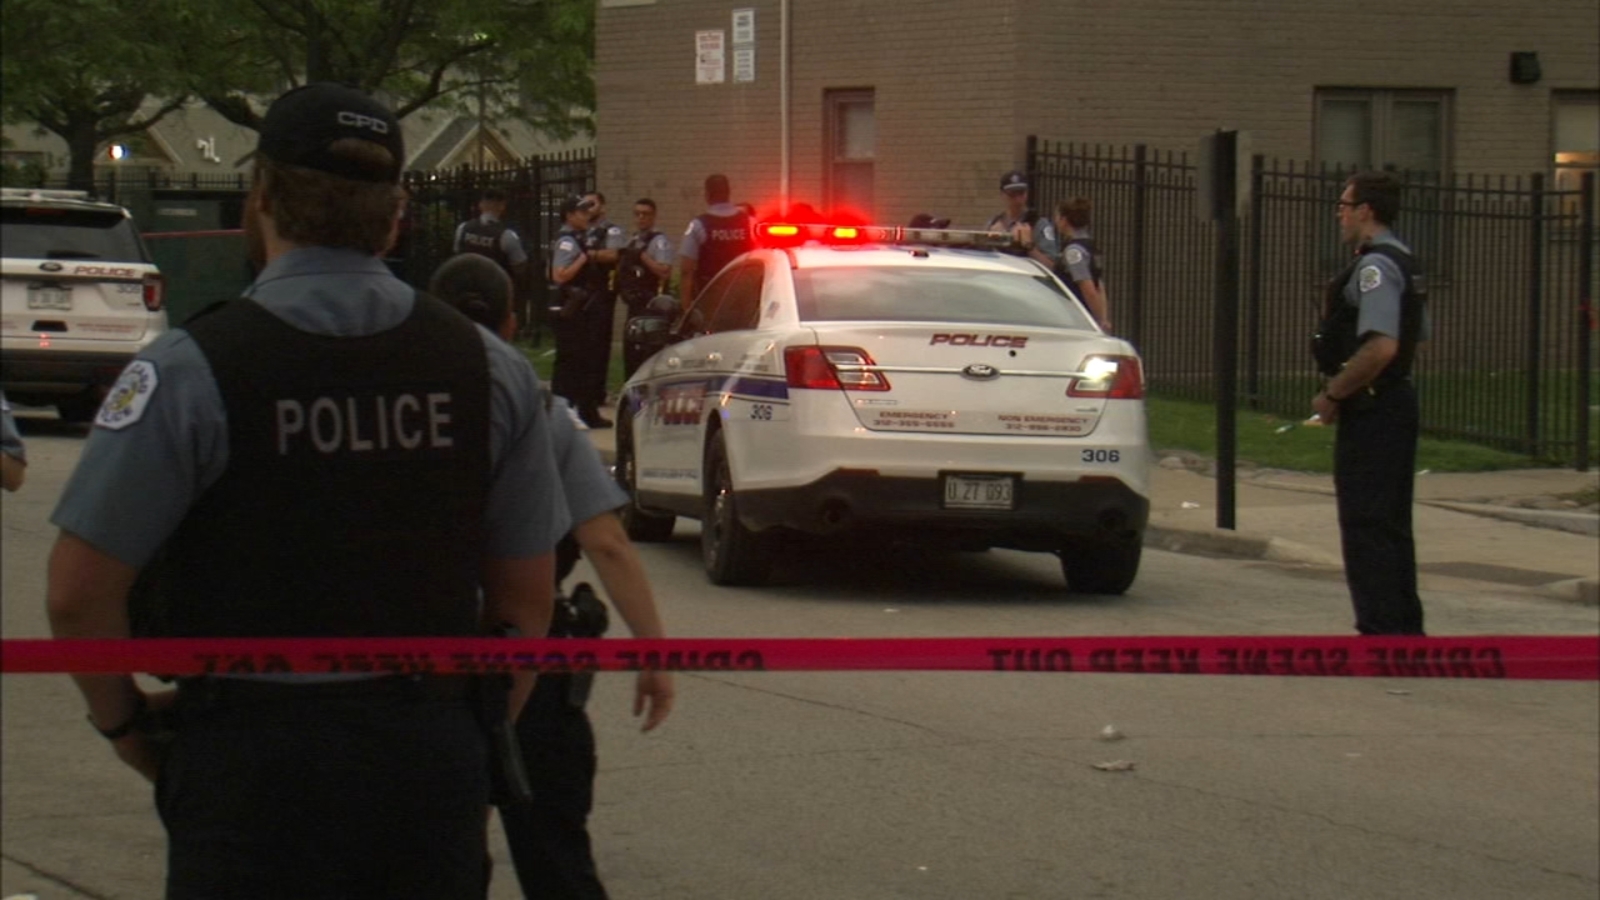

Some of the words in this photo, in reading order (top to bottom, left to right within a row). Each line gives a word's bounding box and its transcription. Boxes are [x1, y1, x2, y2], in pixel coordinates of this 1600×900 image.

[338, 111, 388, 133] CPD
[465, 232, 494, 247] POLICE
[711, 228, 746, 241] POLICE
[74, 265, 135, 277] POLICE
[930, 333, 1029, 348] POLICE
[750, 404, 772, 420] 306
[880, 411, 948, 419] EMERGENCY
[998, 414, 1021, 422] NON
[1025, 415, 1089, 424] EMERGENCY
[276, 393, 453, 455] POLICE
[1082, 449, 1120, 463] 306
[963, 482, 980, 500] 27
